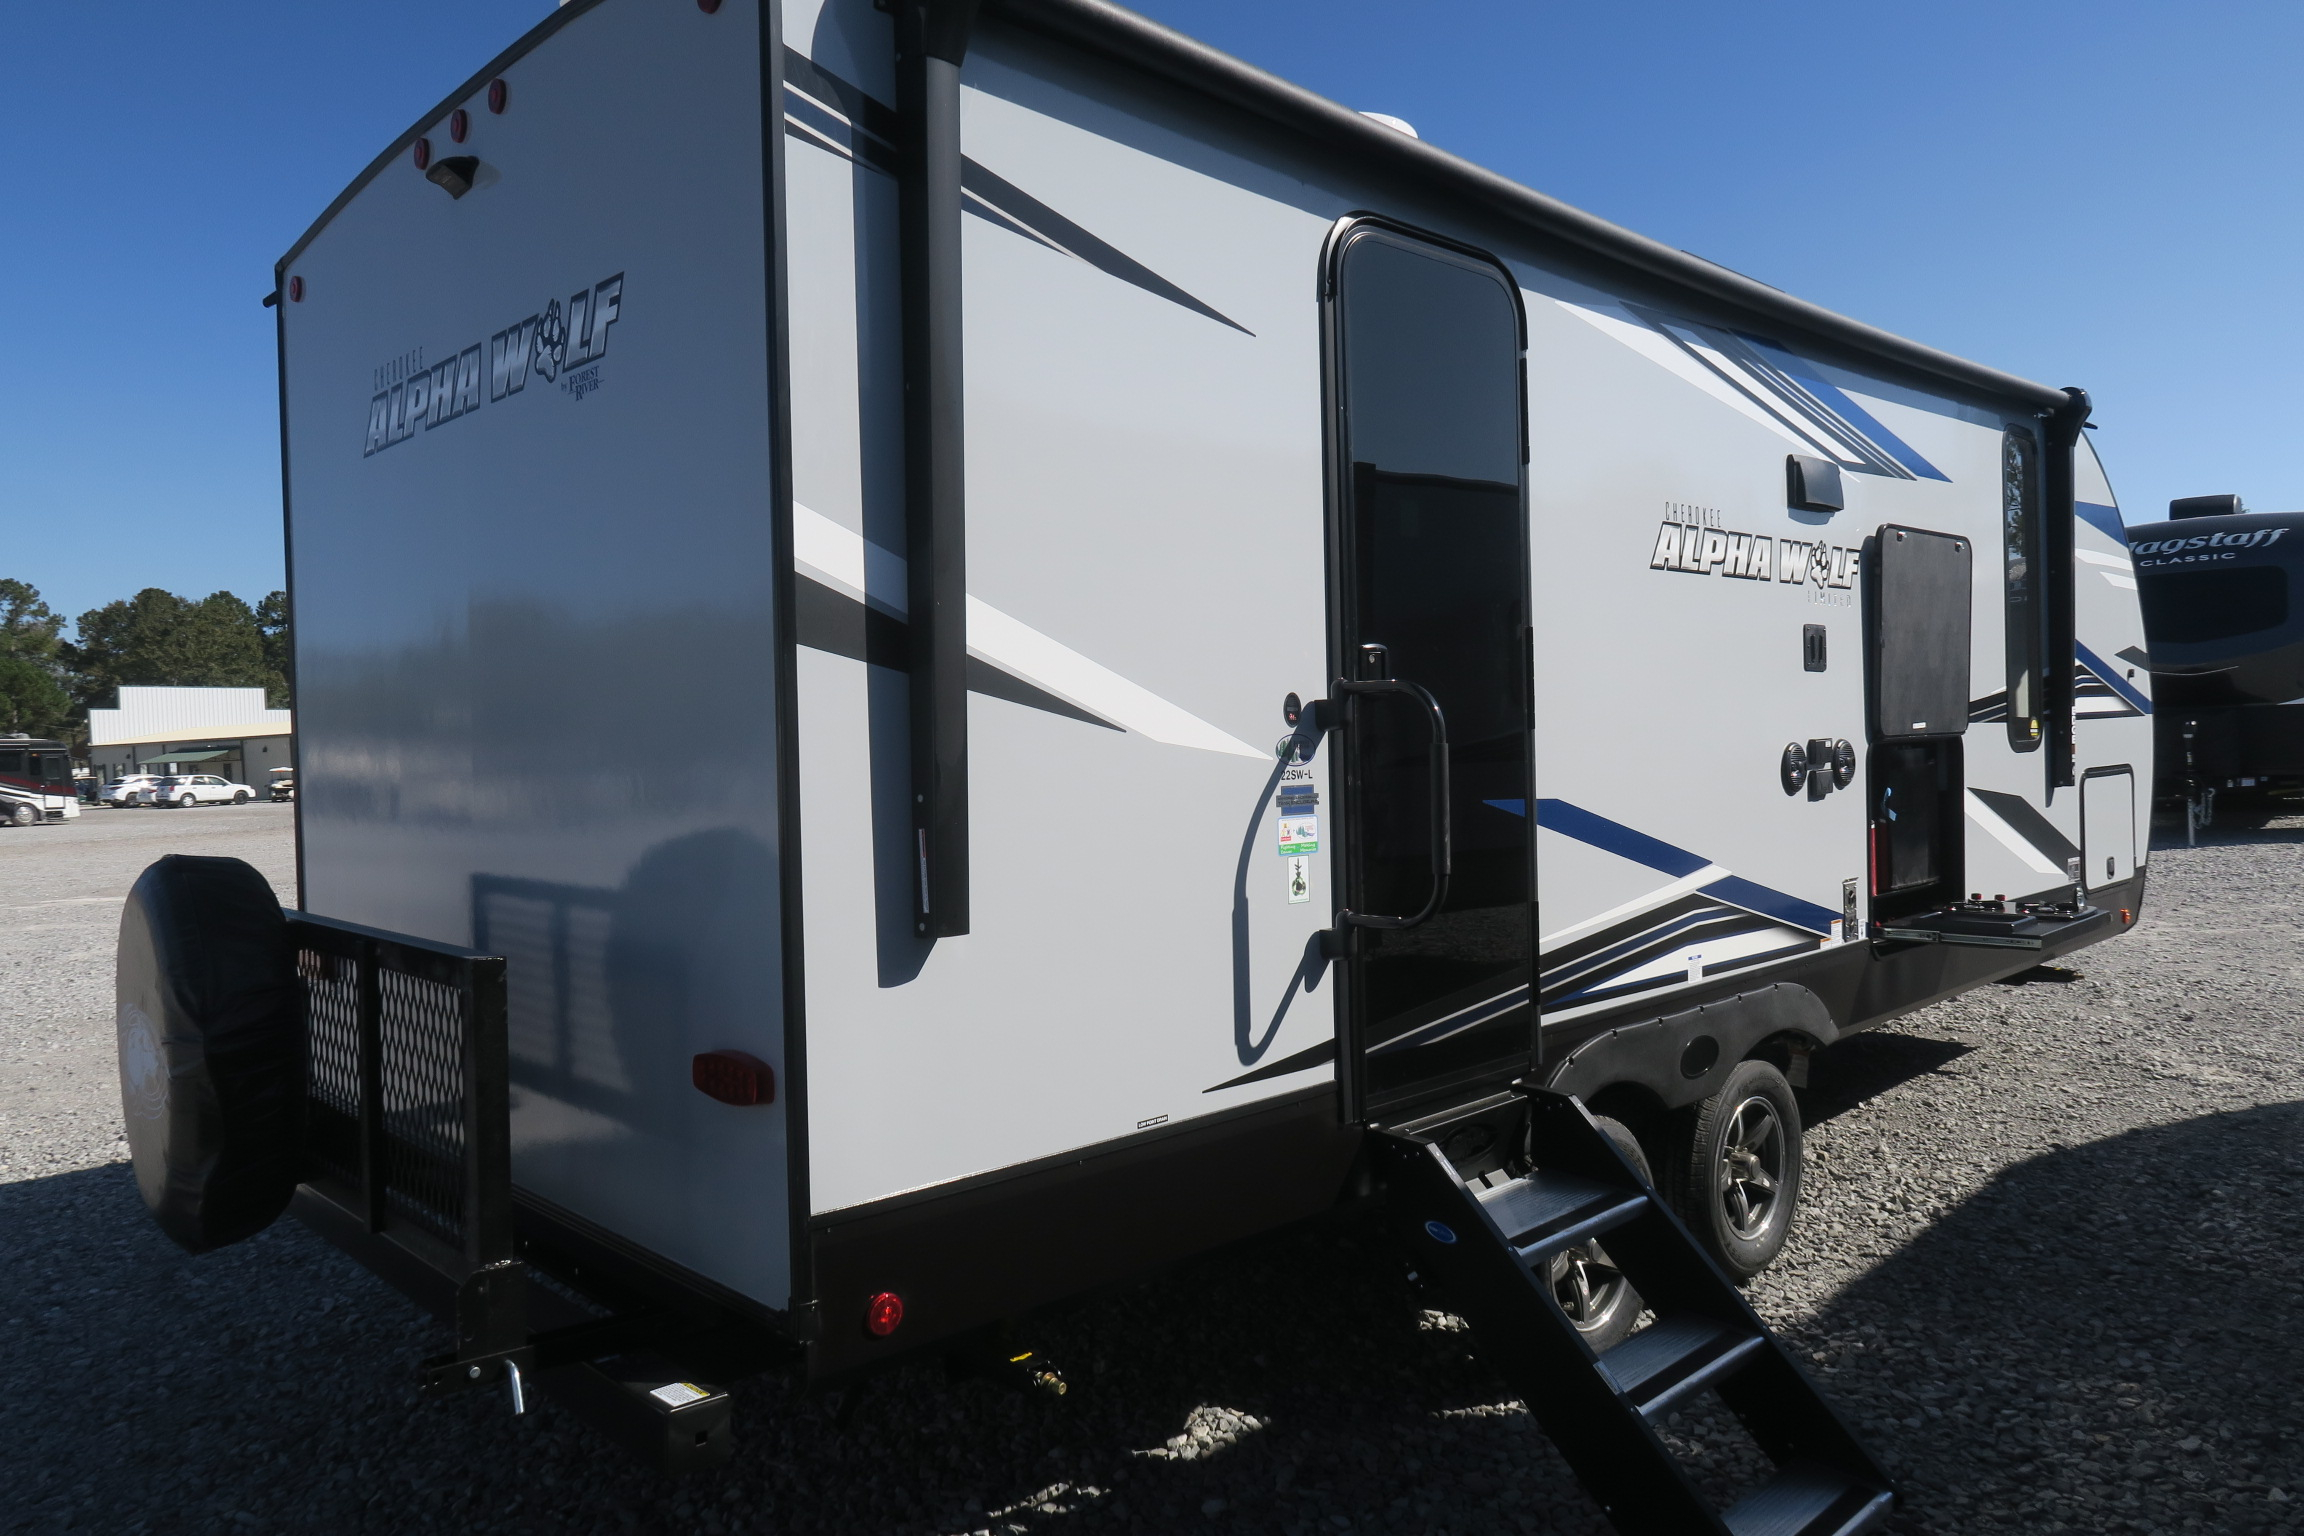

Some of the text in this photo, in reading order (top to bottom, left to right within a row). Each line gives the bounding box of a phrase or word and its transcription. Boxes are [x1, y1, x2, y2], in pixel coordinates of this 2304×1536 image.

[374, 345, 423, 391] CHEROKEE
[568, 365, 600, 392] FOREST
[363, 342, 482, 459] ALPHA
[575, 377, 600, 401] RIVER
[1664, 501, 1722, 528] CHEROKEE
[1649, 520, 1773, 582] ALPHA
[2129, 528, 2290, 555] agstaff
[2139, 552, 2237, 567] CLASSIC
[1281, 769, 1313, 780] 22SW-L
